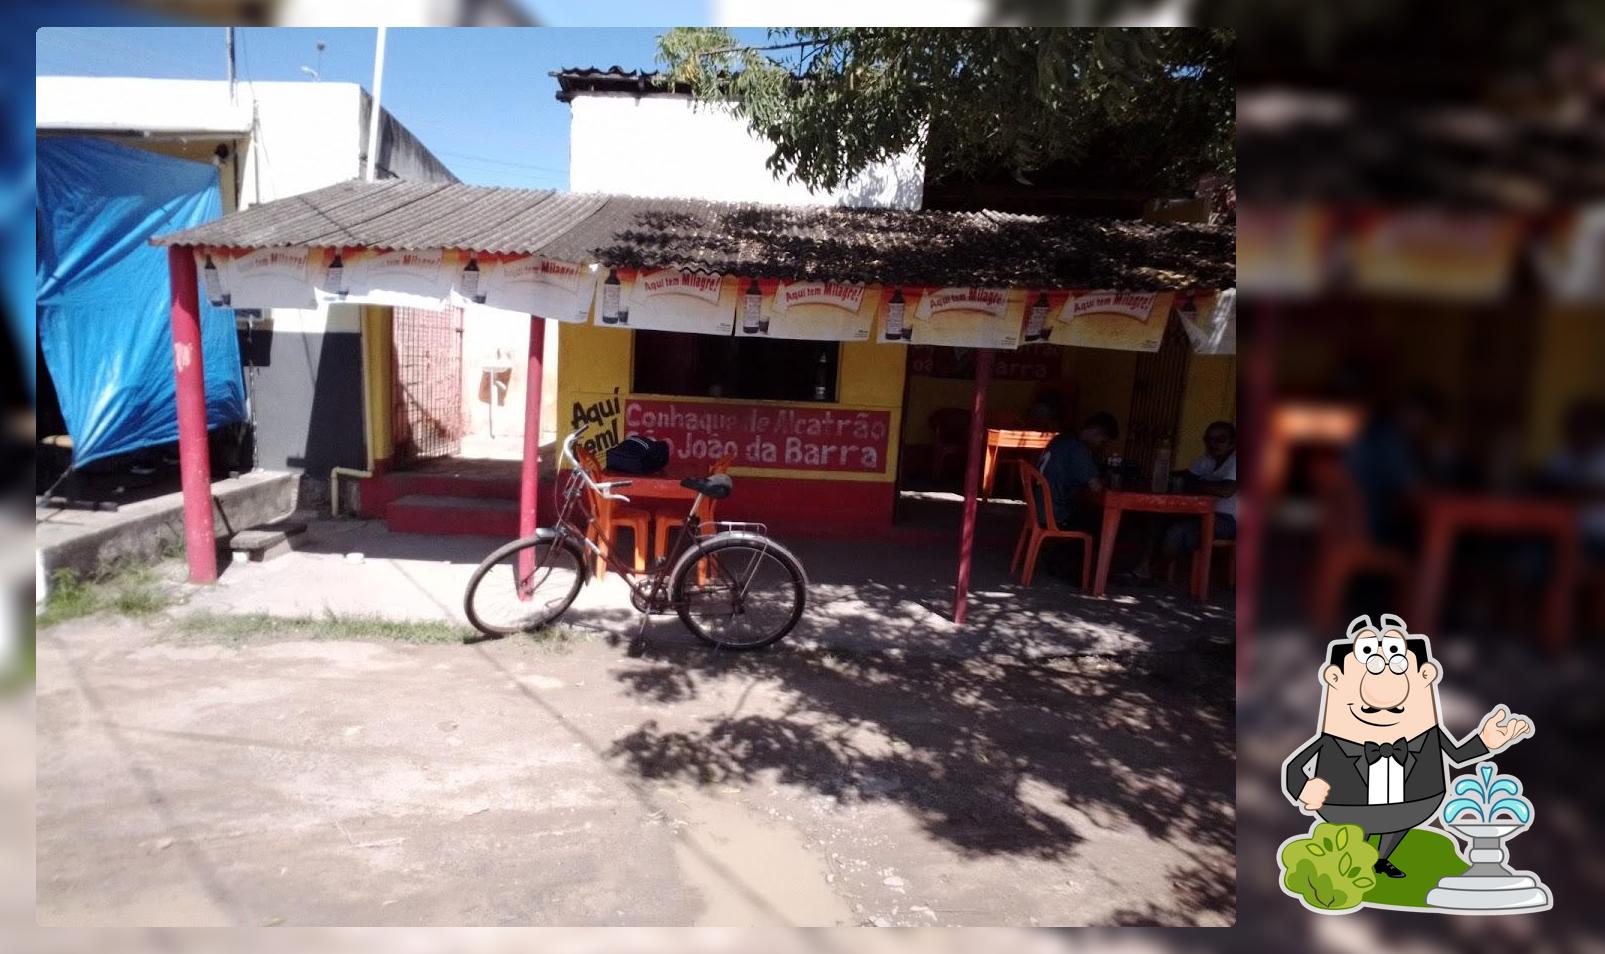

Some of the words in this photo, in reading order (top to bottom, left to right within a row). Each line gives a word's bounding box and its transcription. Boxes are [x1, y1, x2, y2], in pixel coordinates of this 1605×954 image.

[644, 279, 664, 293] Aqui
[665, 277, 680, 286] tem
[682, 274, 720, 293] Milagre!
[786, 290, 806, 303] Aqui
[807, 287, 821, 297] tem
[823, 283, 864, 303] Milagre!
[951, 294, 966, 302] tem
[1074, 300, 1096, 313] Aqui
[1097, 298, 1113, 307] tem
[625, 403, 737, 434] Conhaque
[774, 410, 885, 440] Alcatrão
[677, 432, 738, 459] João
[746, 435, 777, 463] da
[784, 436, 878, 468] Barra
